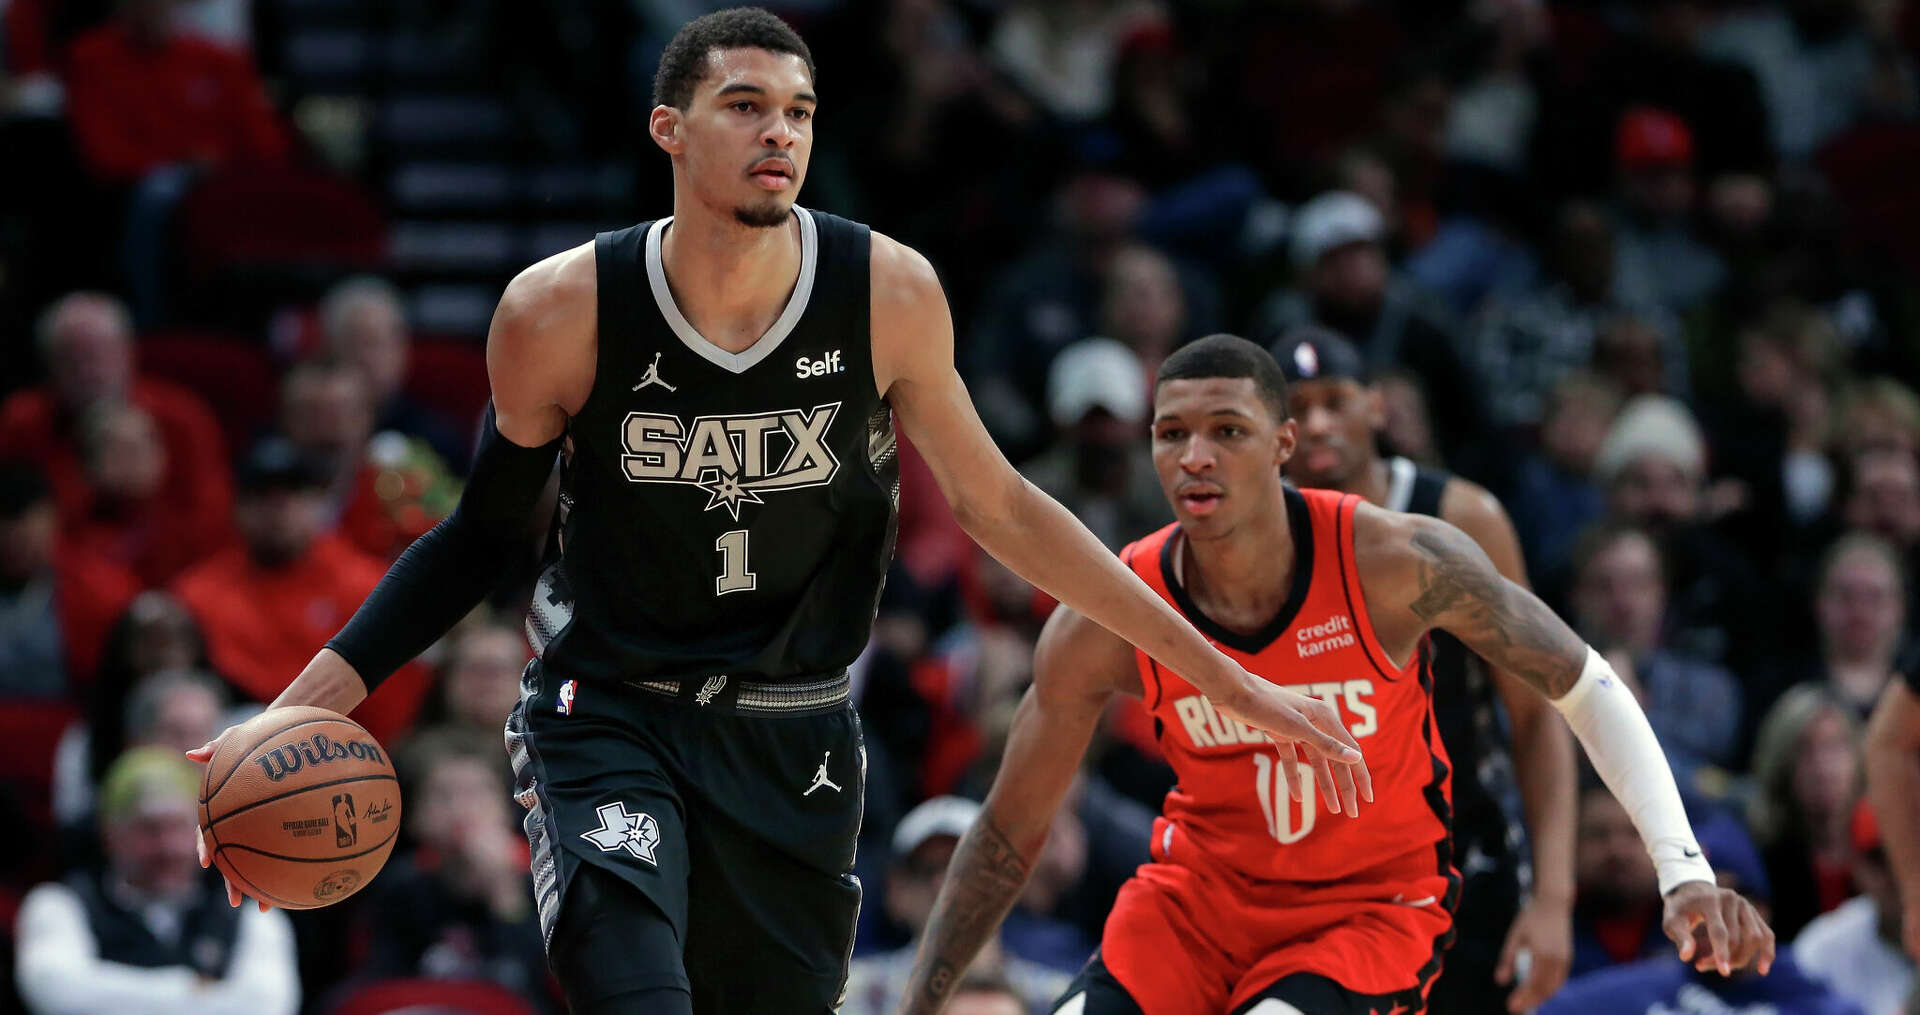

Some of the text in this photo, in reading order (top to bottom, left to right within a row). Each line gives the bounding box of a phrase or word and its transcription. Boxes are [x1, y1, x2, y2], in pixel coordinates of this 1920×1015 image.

[796, 350, 845, 379] Self.
[621, 401, 842, 488] SATX
[716, 530, 756, 596] 1
[1297, 615, 1349, 642] credit
[1297, 633, 1355, 658] karma
[254, 733, 385, 782] Wilson
[1253, 752, 1316, 845] 10
